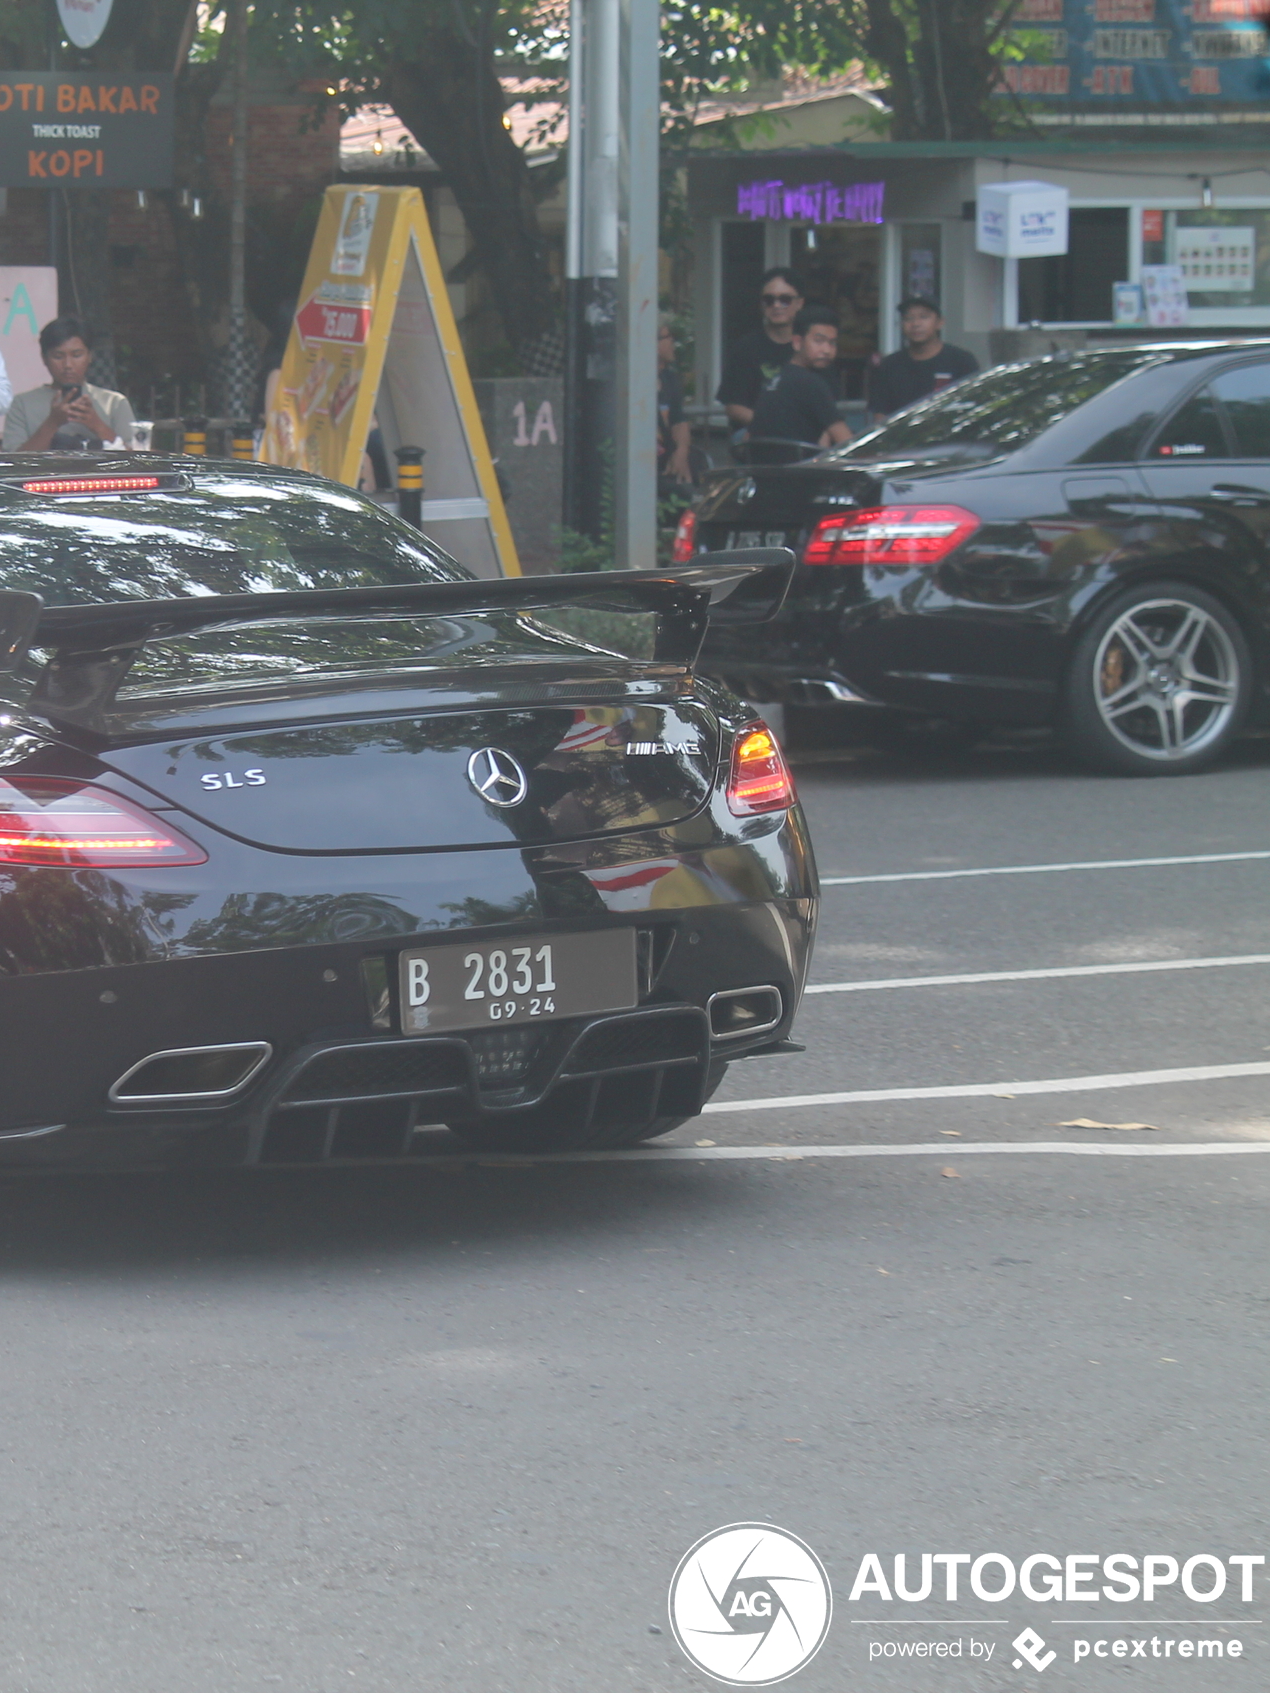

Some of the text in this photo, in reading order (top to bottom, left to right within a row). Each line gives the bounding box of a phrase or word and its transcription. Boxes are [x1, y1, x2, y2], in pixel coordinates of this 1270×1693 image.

[56, 84, 160, 114] BAKAR
[32, 124, 101, 139] THICK TOAST
[28, 150, 104, 178] KOPI
[512, 400, 558, 447] 1A
[200, 768, 267, 792] SLS
[408, 944, 557, 1007] B 2831
